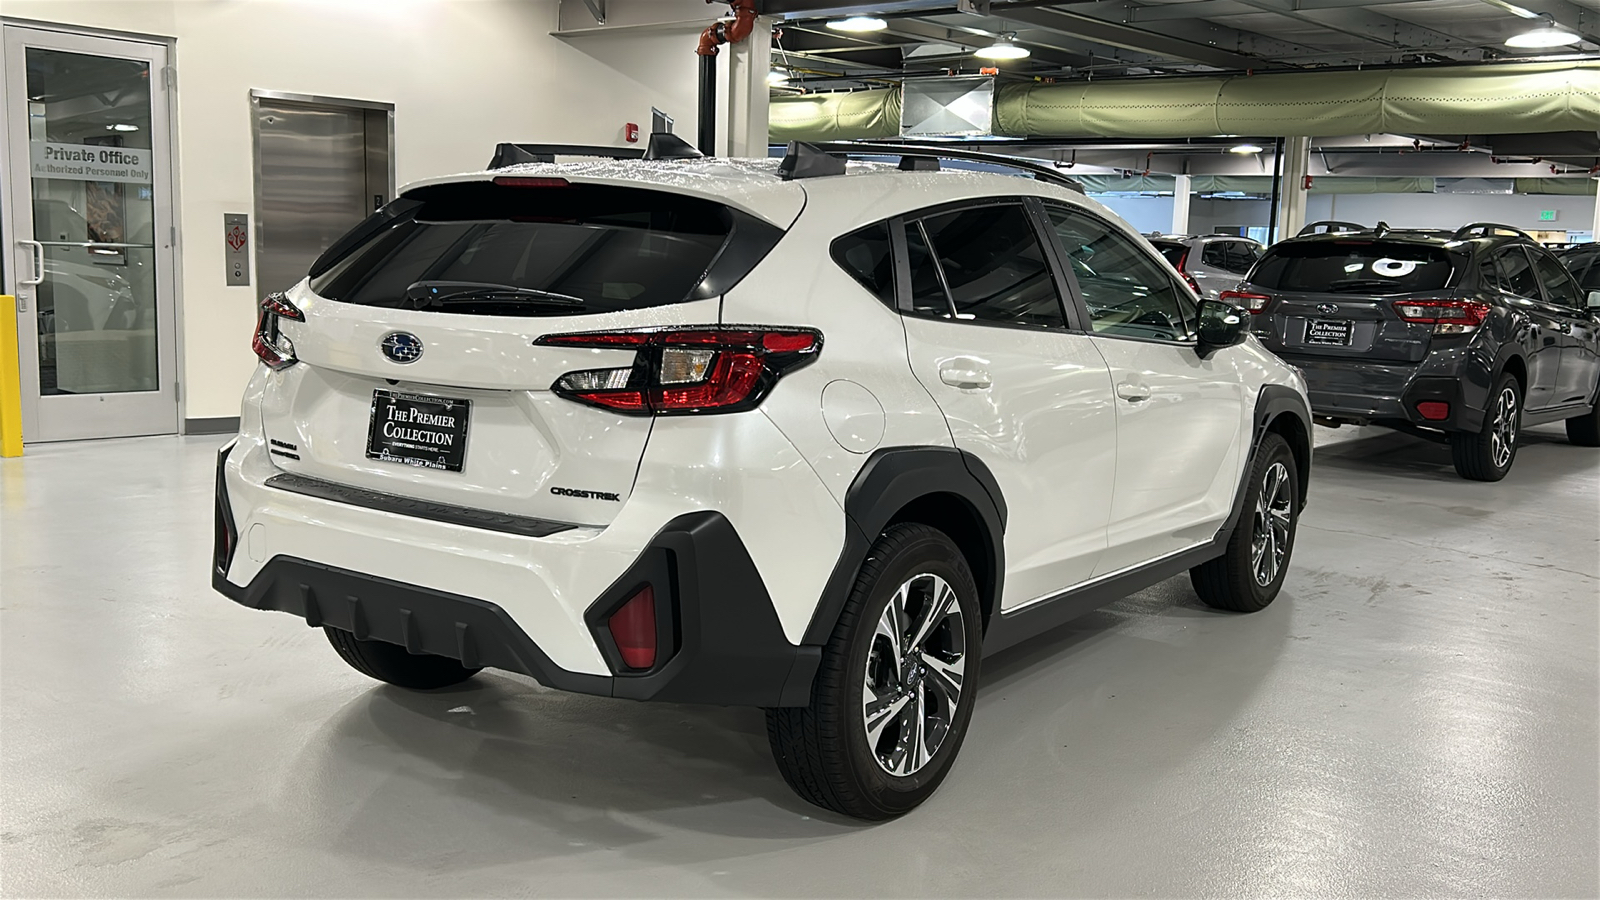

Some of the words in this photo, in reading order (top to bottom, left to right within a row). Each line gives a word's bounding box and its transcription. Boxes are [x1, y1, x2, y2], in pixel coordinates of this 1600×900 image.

[45, 146, 95, 162] Private
[99, 150, 139, 165] Office
[85, 166, 128, 177] Personnel
[130, 169, 149, 180] Only
[1309, 329, 1347, 338] COLLECTION
[1322, 323, 1347, 331] PREMIER
[386, 404, 408, 422] THE
[408, 407, 456, 428] PREMIER
[383, 421, 454, 446] COLLECTION
[380, 455, 402, 463] Subaru
[404, 456, 424, 466] White
[424, 460, 447, 470] Plains
[550, 486, 621, 502] CROSSTREK
